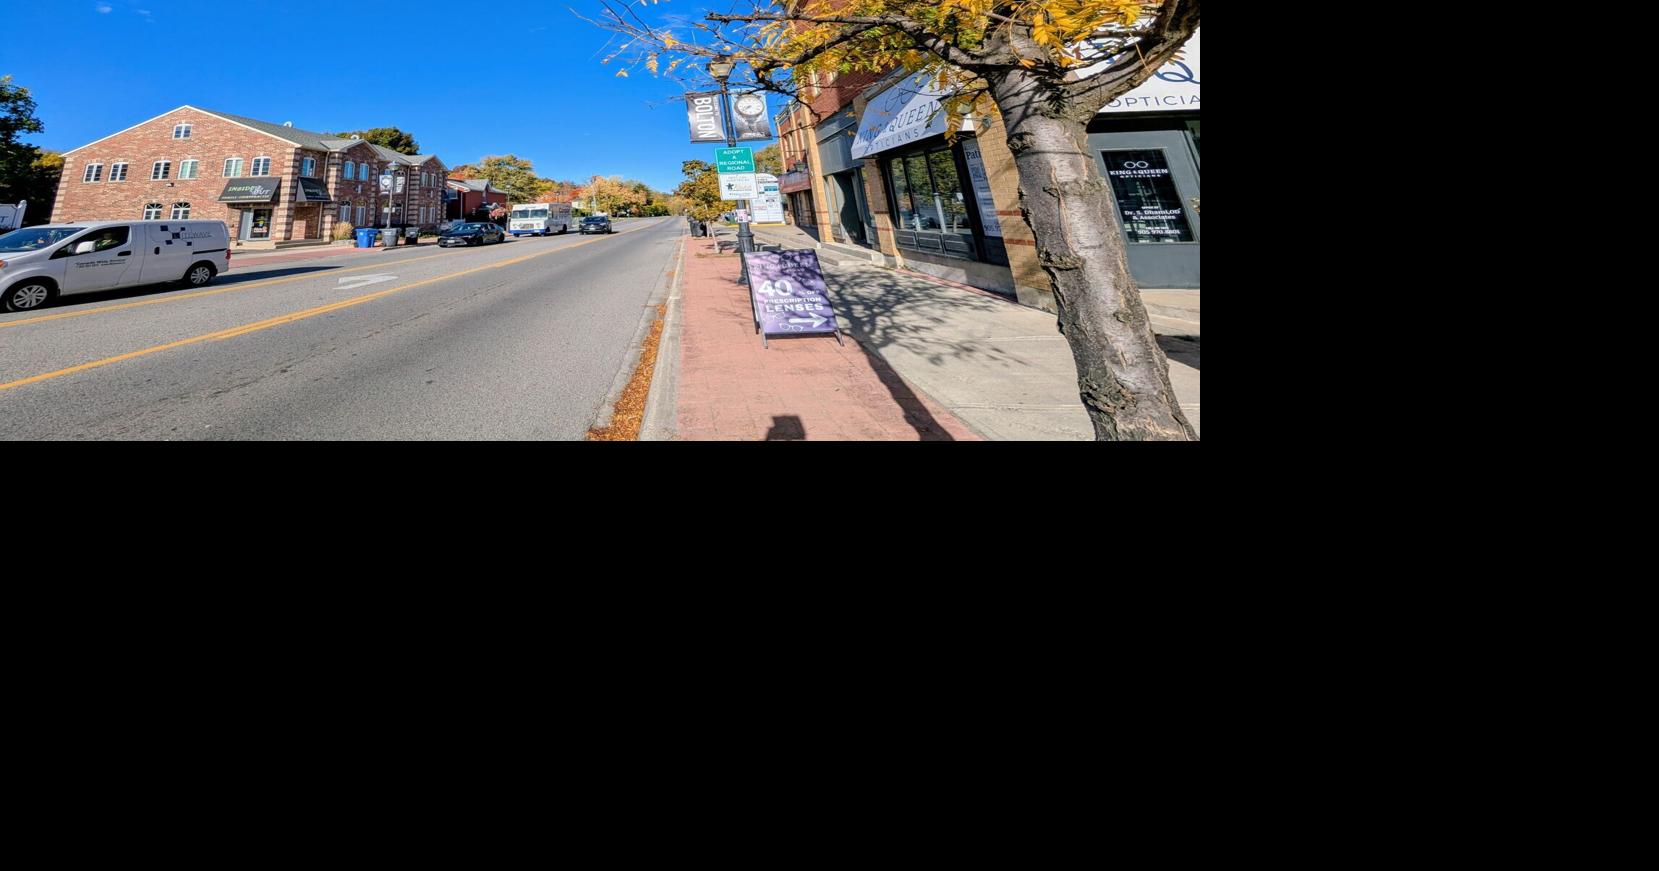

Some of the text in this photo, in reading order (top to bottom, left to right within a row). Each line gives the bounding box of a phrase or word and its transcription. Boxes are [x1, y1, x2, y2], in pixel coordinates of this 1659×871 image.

[694, 96, 718, 139] BOLTON
[889, 101, 939, 132] QUEEN
[758, 279, 793, 297] 40
[765, 303, 824, 313] LENSES
